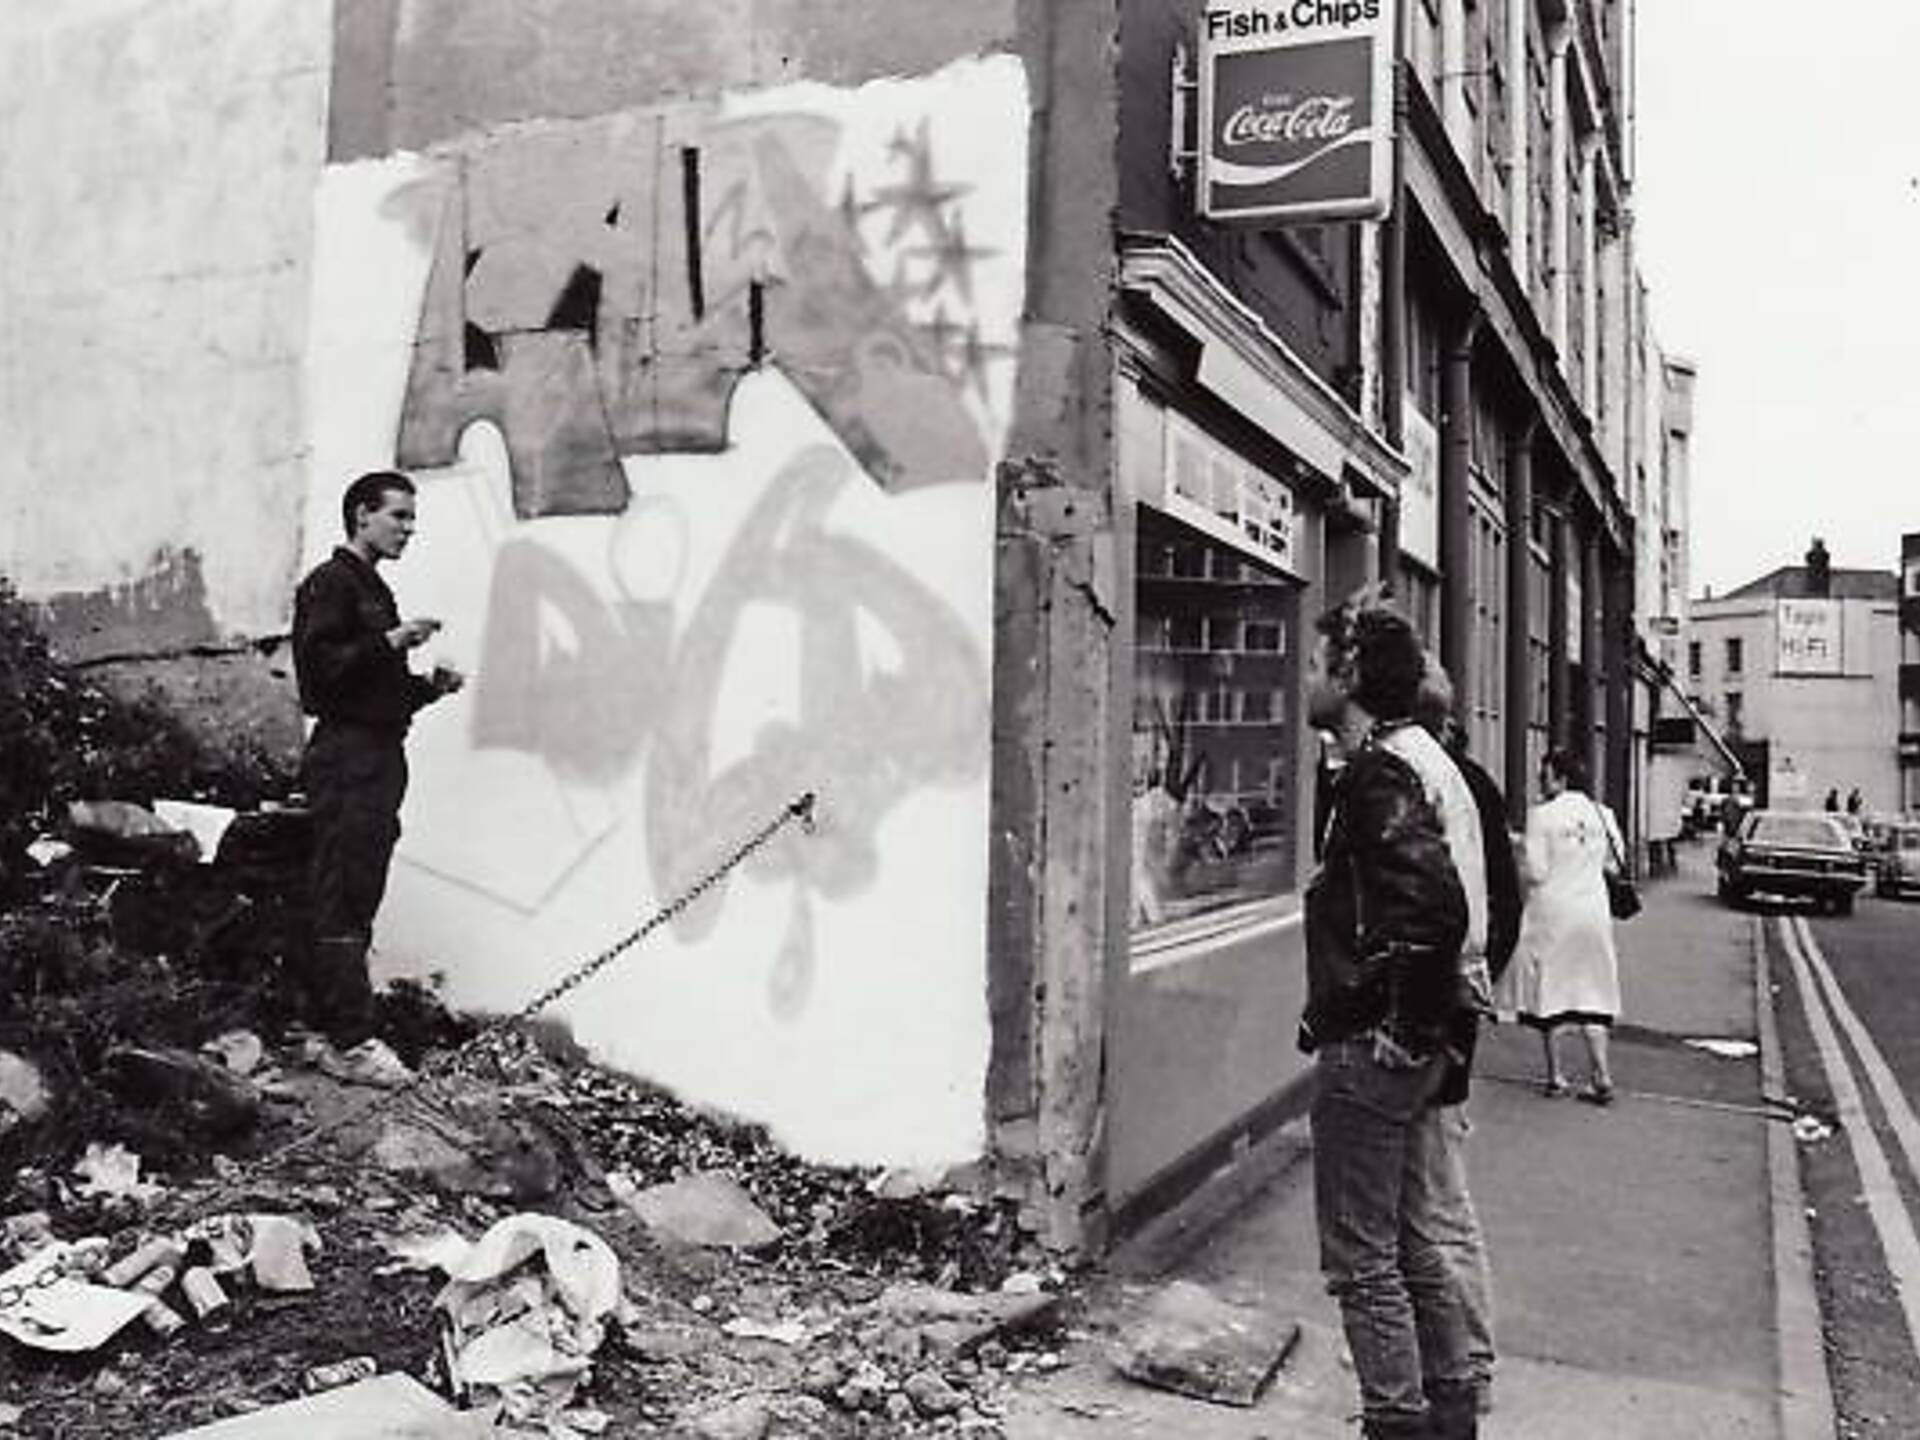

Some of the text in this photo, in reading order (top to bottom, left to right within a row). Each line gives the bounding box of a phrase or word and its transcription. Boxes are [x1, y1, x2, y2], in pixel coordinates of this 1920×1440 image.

[1207, 0, 1380, 40] Fish & Chips
